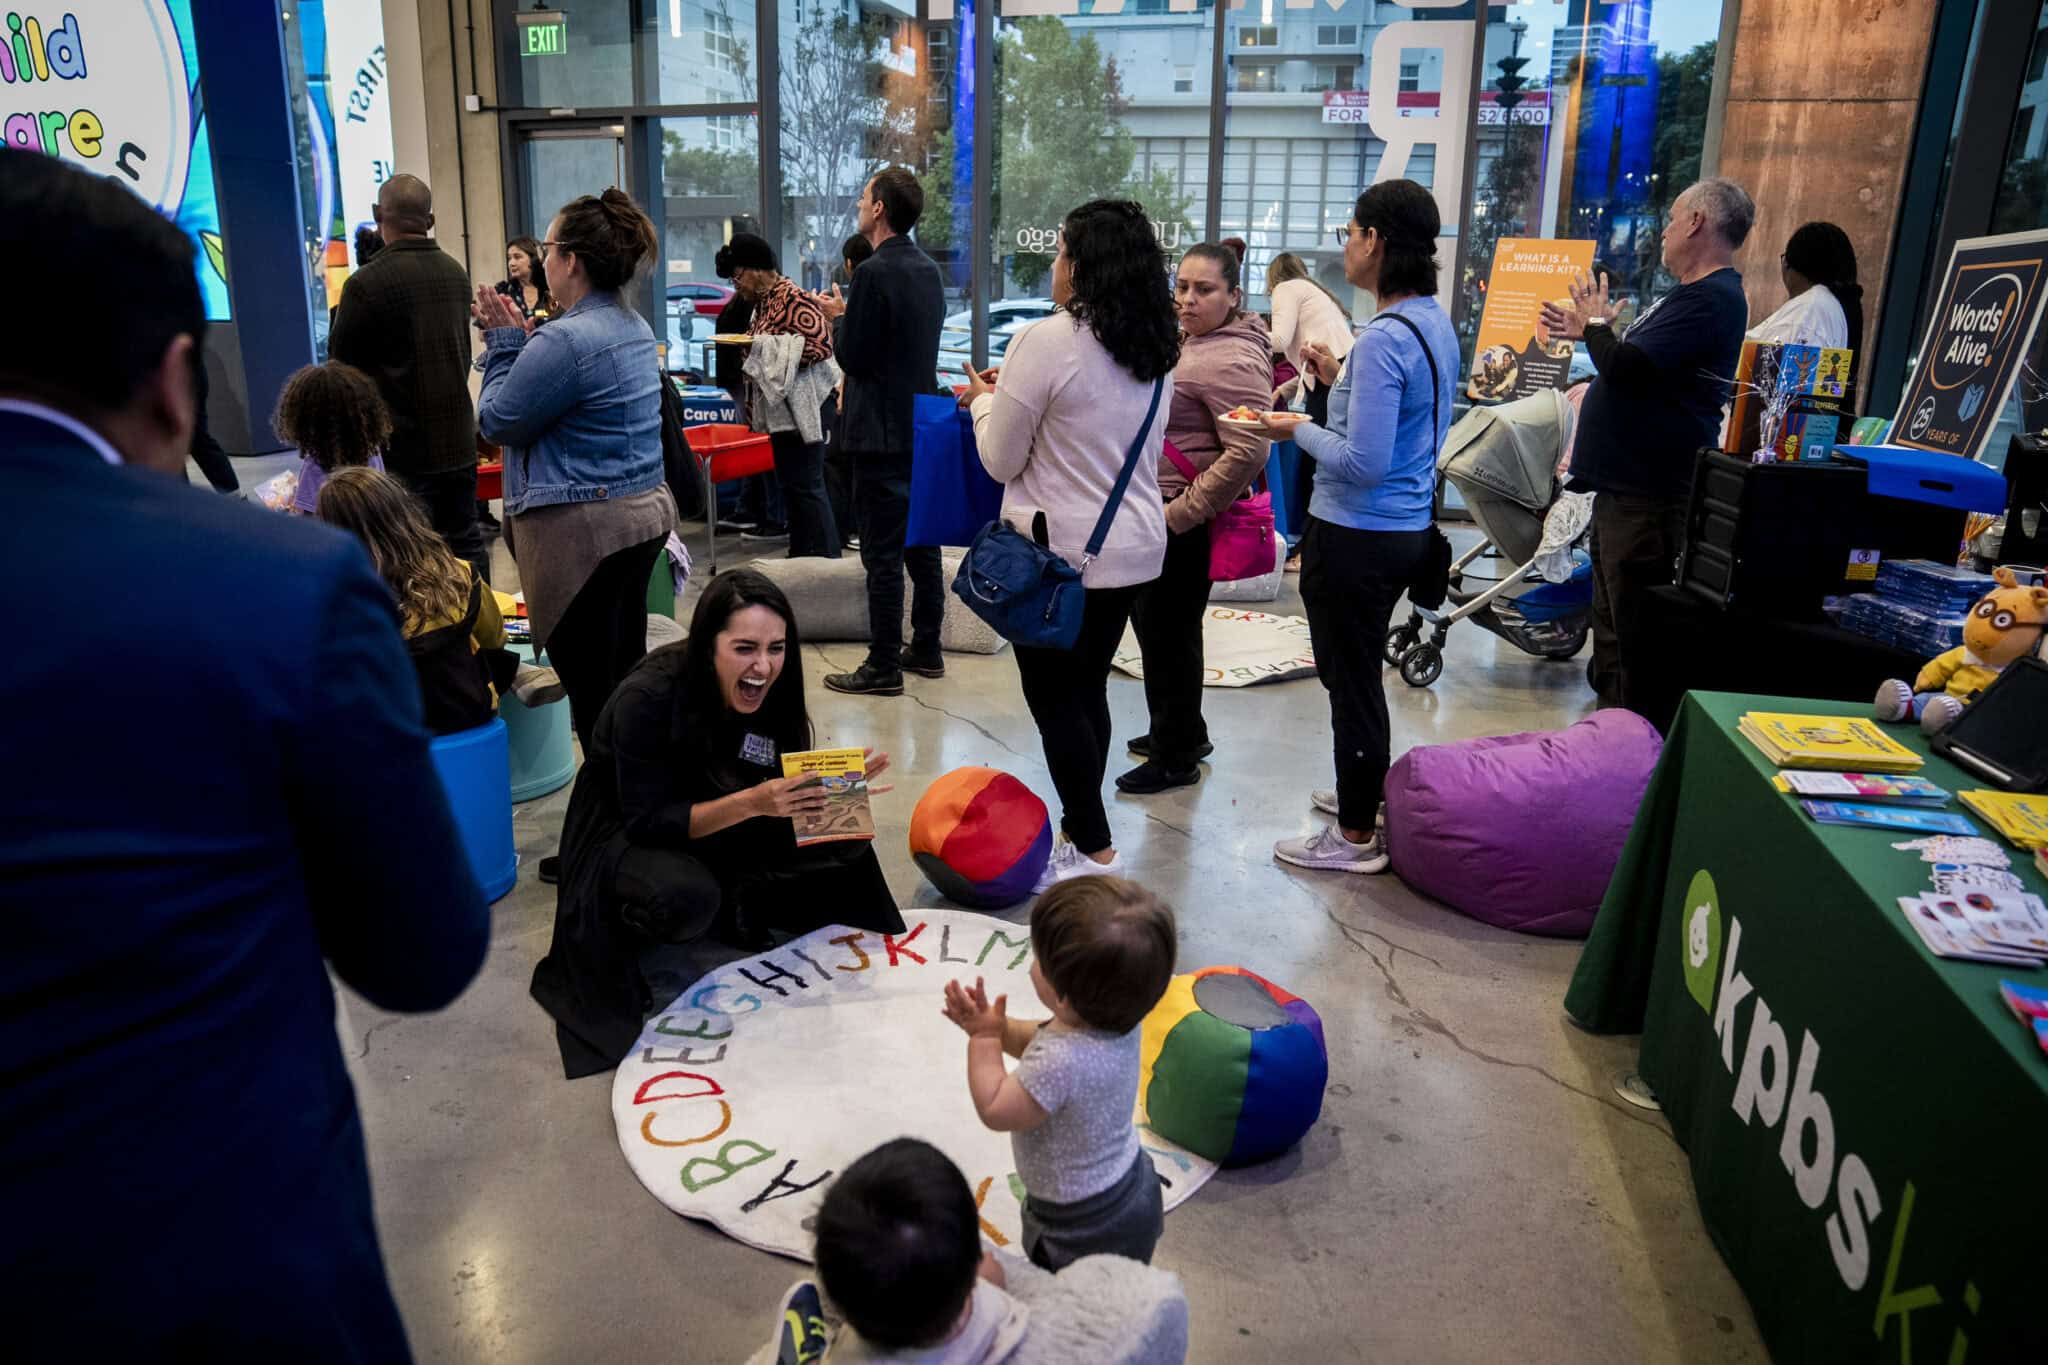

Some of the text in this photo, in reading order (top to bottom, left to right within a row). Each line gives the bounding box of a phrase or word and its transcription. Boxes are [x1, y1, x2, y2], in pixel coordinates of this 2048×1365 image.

[528, 25, 559, 53] EXIT
[1328, 108, 1362, 121] FOR
[0, 108, 104, 159] are
[1514, 252, 1570, 264] WHAT IS A
[1499, 262, 1582, 275] LEARNING KIT?
[1949, 301, 2003, 333] Words
[683, 407, 718, 421] Care
[1912, 407, 1934, 429] 25
[1926, 428, 1961, 445] YEARS OF
[1713, 915, 1883, 1292] kpbs
